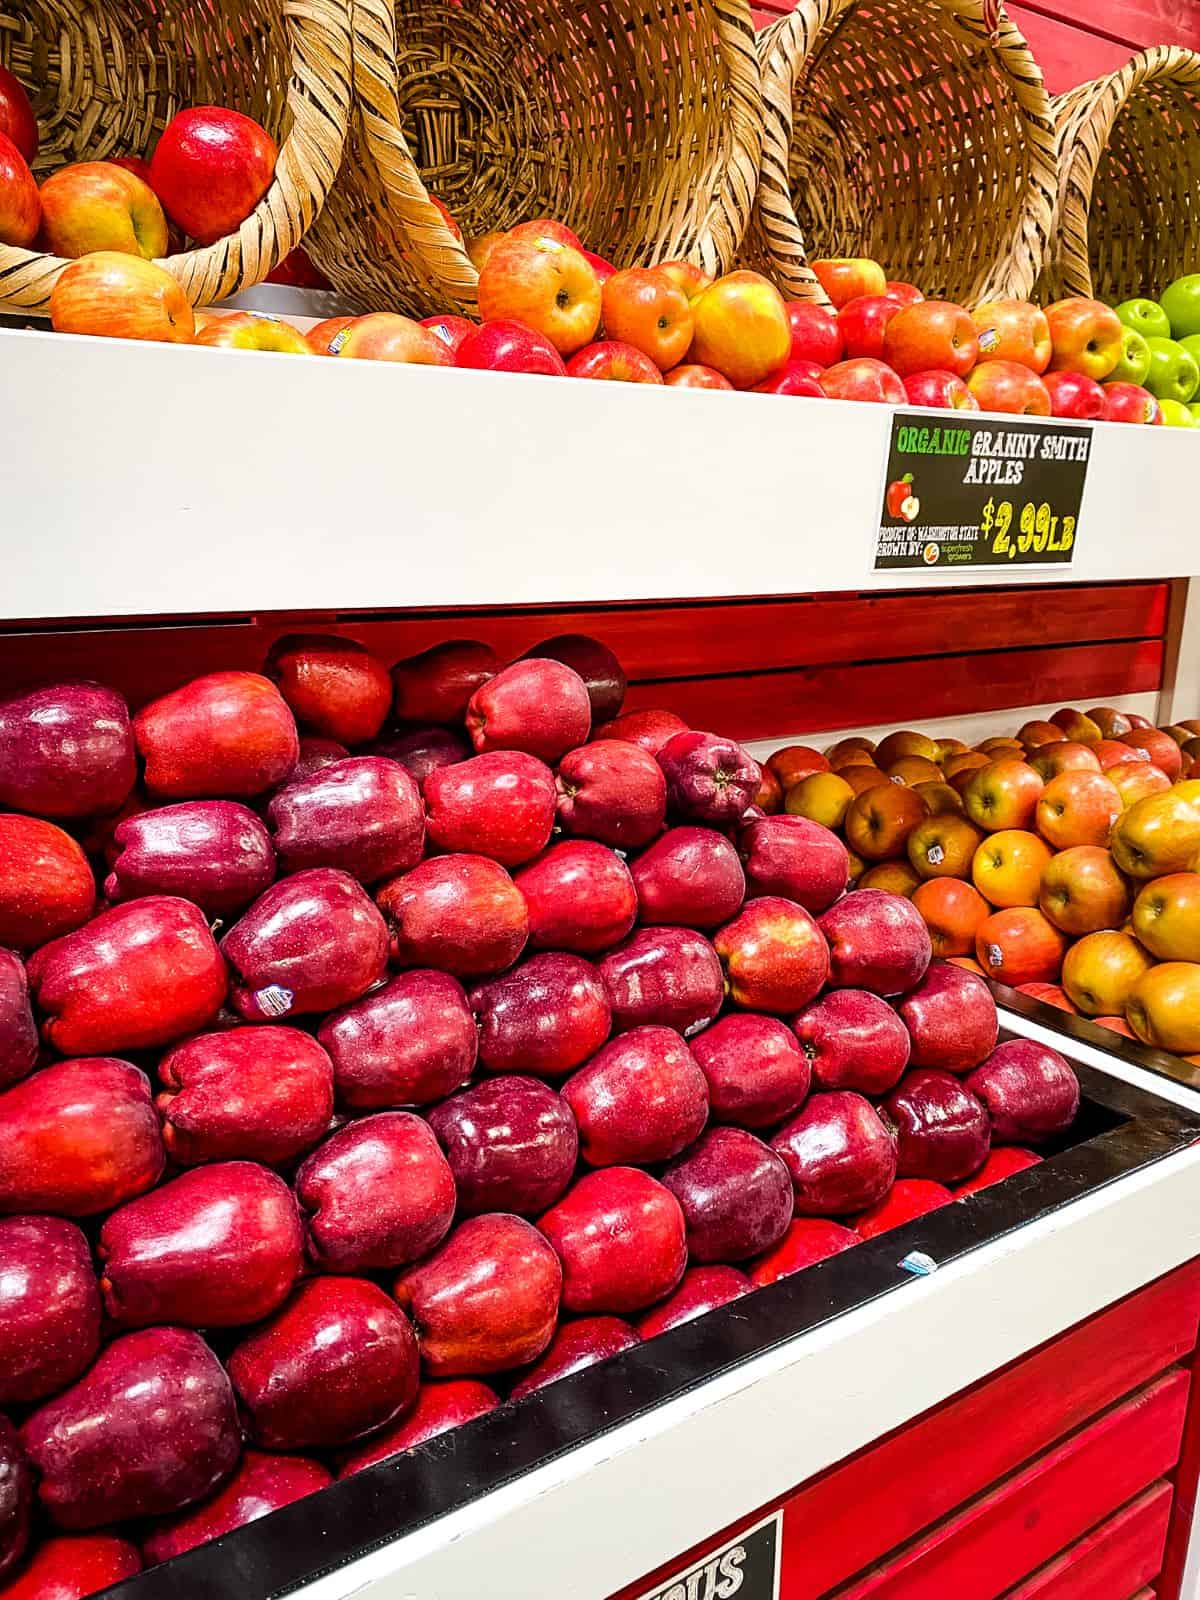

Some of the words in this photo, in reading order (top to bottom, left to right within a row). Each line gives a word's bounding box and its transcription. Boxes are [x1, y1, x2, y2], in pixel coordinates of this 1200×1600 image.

[897, 426, 970, 455] ORGANIC
[971, 431, 1041, 458] GRANNY
[1040, 435, 1090, 461] SMITH
[963, 458, 1024, 484] APPLES
[877, 541, 907, 557] GROWN
